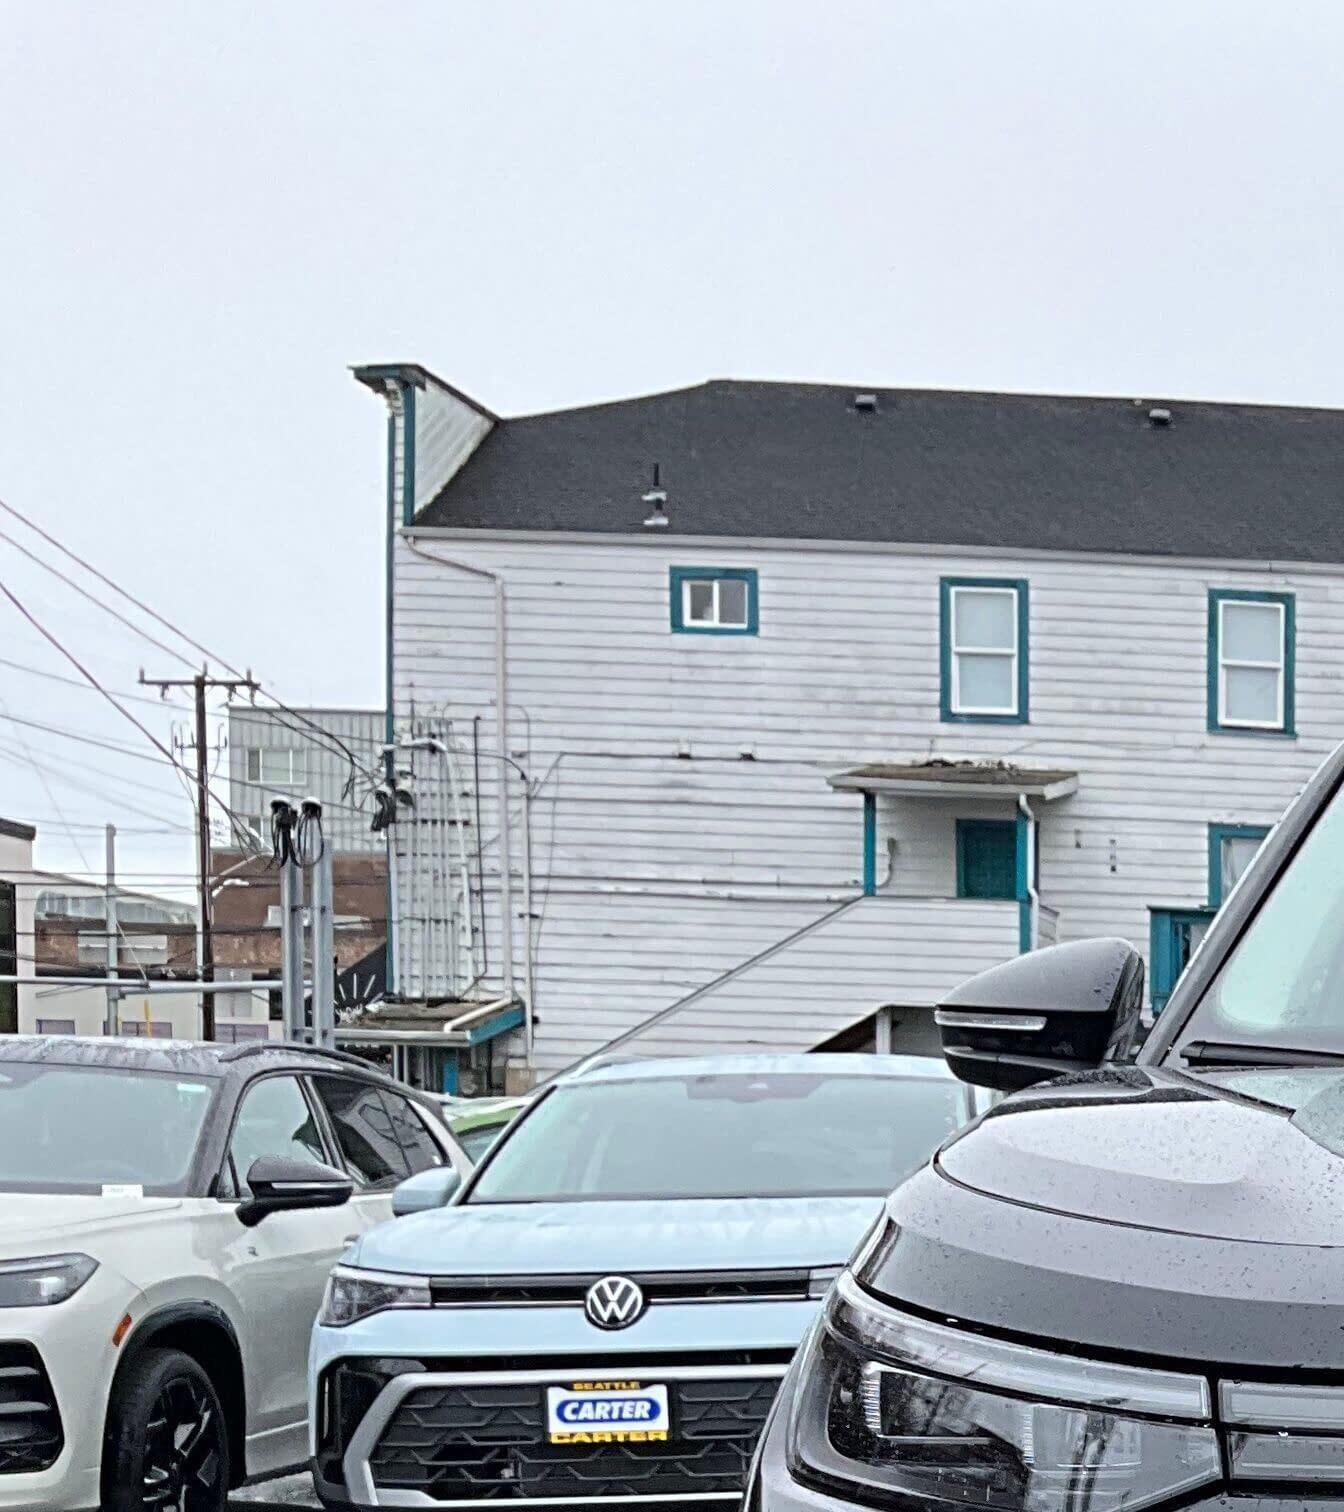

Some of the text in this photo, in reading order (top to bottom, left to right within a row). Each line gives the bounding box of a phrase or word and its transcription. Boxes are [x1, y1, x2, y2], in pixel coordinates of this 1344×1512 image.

[588, 1277, 641, 1325] VW
[572, 1381, 640, 1391] SEATTLE
[563, 1401, 651, 1421] CARTER
[550, 1431, 668, 1444] CARTER
